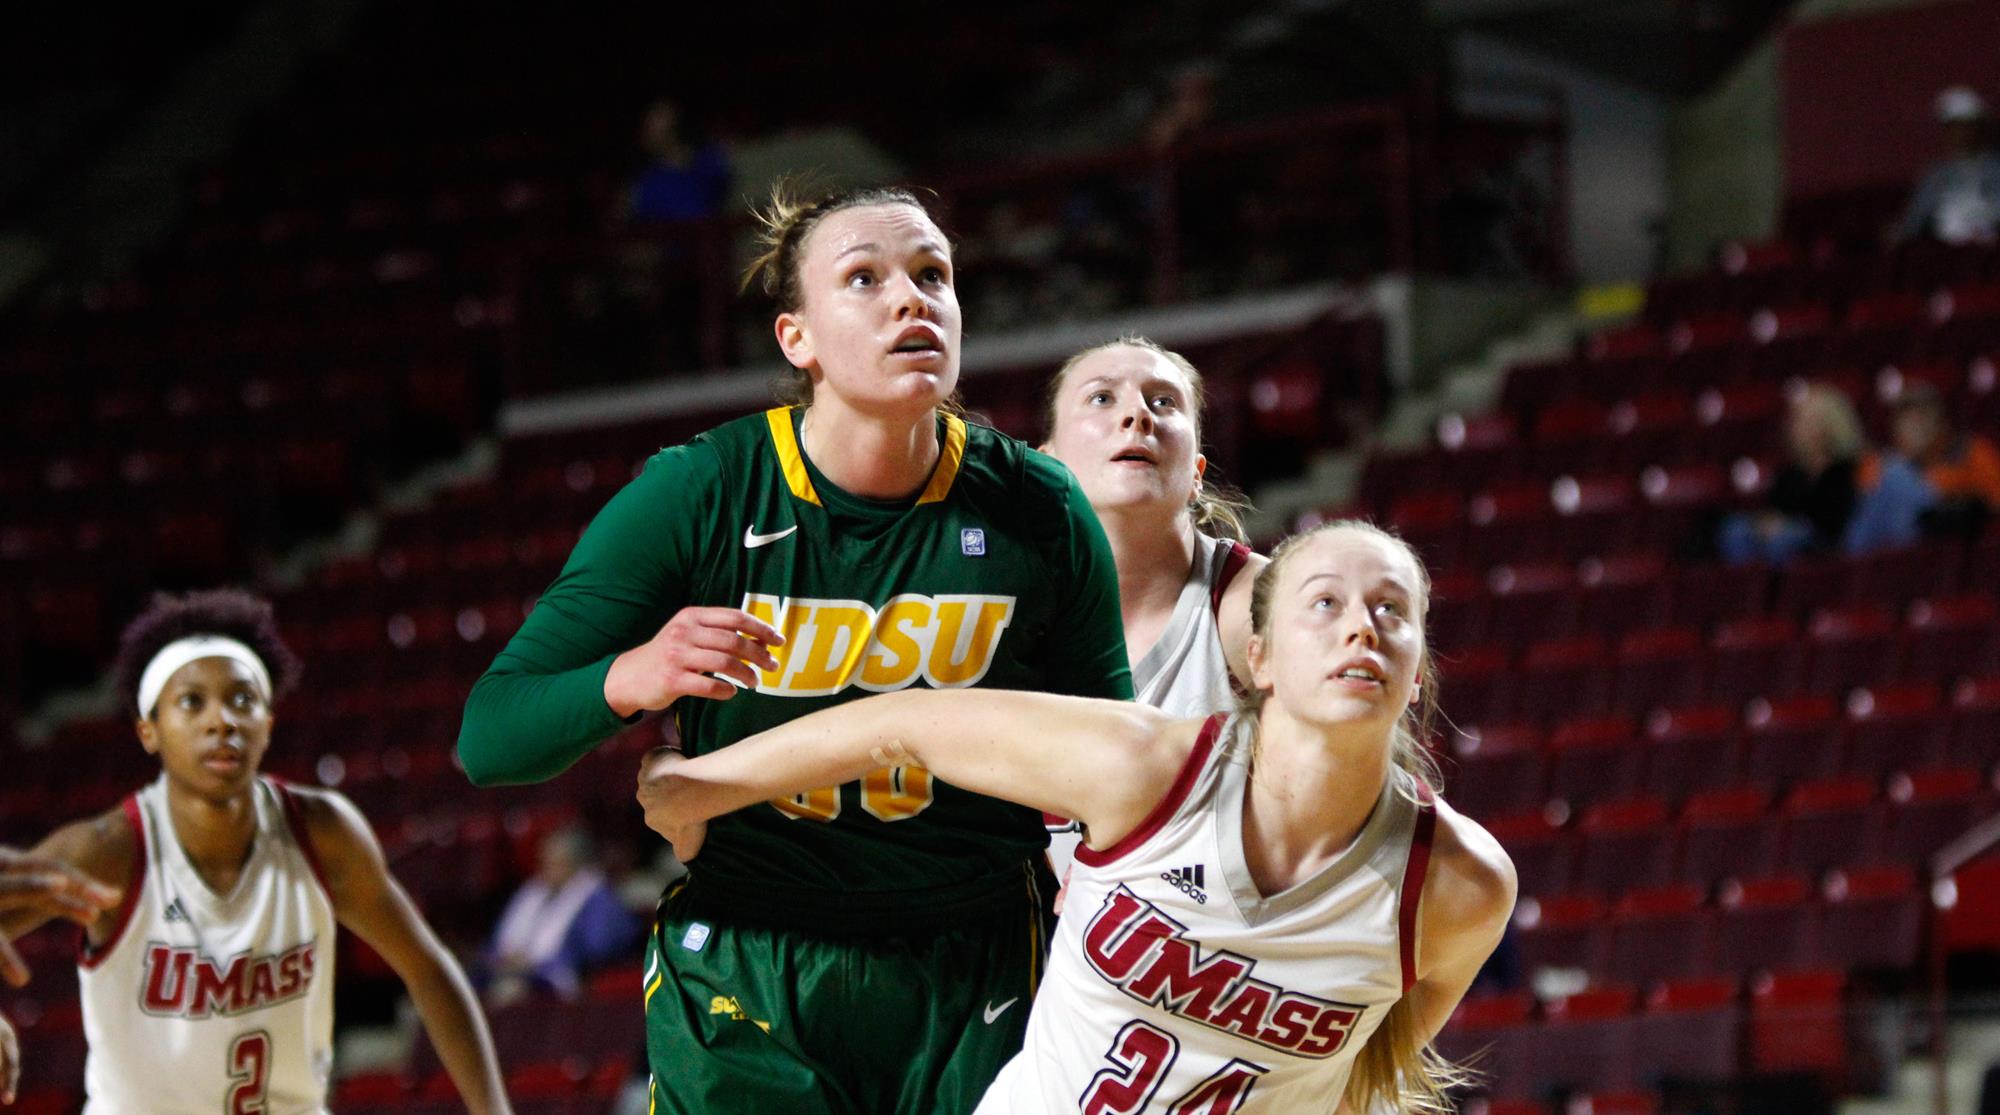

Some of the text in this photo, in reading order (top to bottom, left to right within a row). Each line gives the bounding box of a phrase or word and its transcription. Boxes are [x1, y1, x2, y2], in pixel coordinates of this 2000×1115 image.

[714, 592, 1016, 697] NDSU
[1160, 872, 1208, 905] adidas
[225, 1030, 272, 1115] 2
